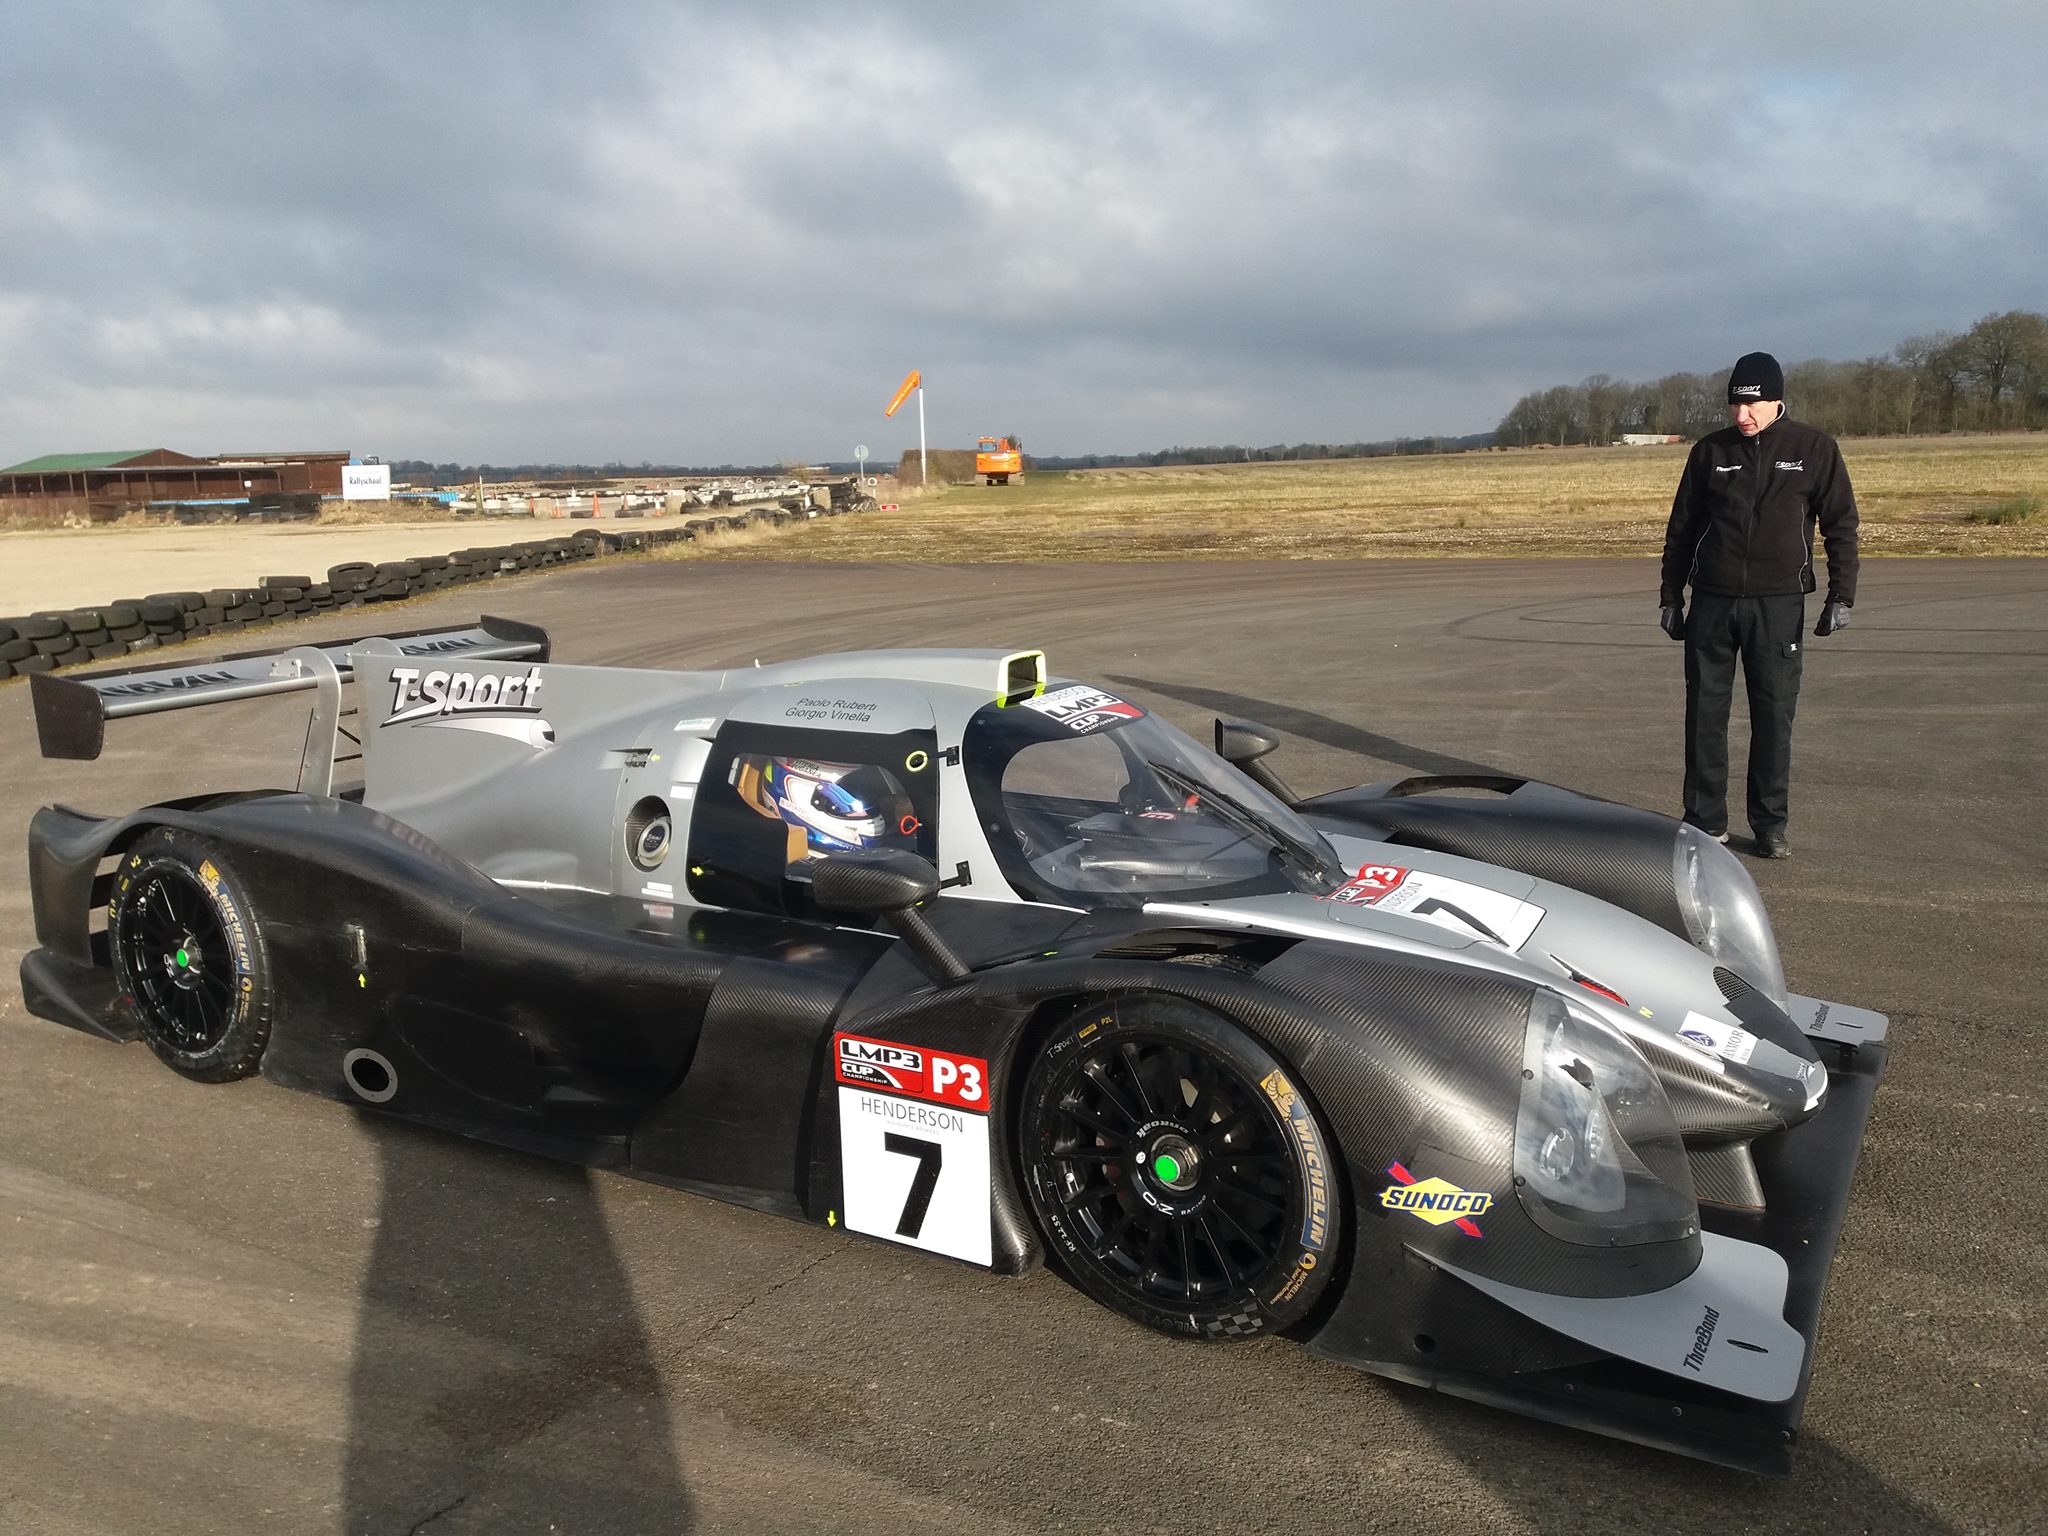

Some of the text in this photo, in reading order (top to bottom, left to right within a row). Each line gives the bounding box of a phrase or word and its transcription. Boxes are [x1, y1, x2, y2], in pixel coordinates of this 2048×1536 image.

[785, 707, 871, 722] Giorgio Vinella
[797, 697, 878, 712] Paolo Ruberti
[1045, 694, 1118, 719] LMP3
[1070, 713, 1101, 731] CUP
[1355, 865, 1399, 890] P3
[220, 892, 251, 972] MICHELIN
[1410, 896, 1511, 949] 7
[841, 1040, 920, 1069] LMP3
[841, 1062, 874, 1076] CUP
[842, 1071, 888, 1084] CHAMPIONSHIP
[931, 1056, 982, 1102] P3
[861, 1096, 963, 1133] HENDERSON
[884, 1131, 942, 1239] 7
[1293, 1118, 1327, 1247] MICHELIN
[1180, 1194, 1207, 1216] RACING
[1386, 1189, 1488, 1213] SUNOCO
[1284, 1270, 1309, 1302] MICHELIN
[1683, 1304, 1720, 1372] ThreeBond
